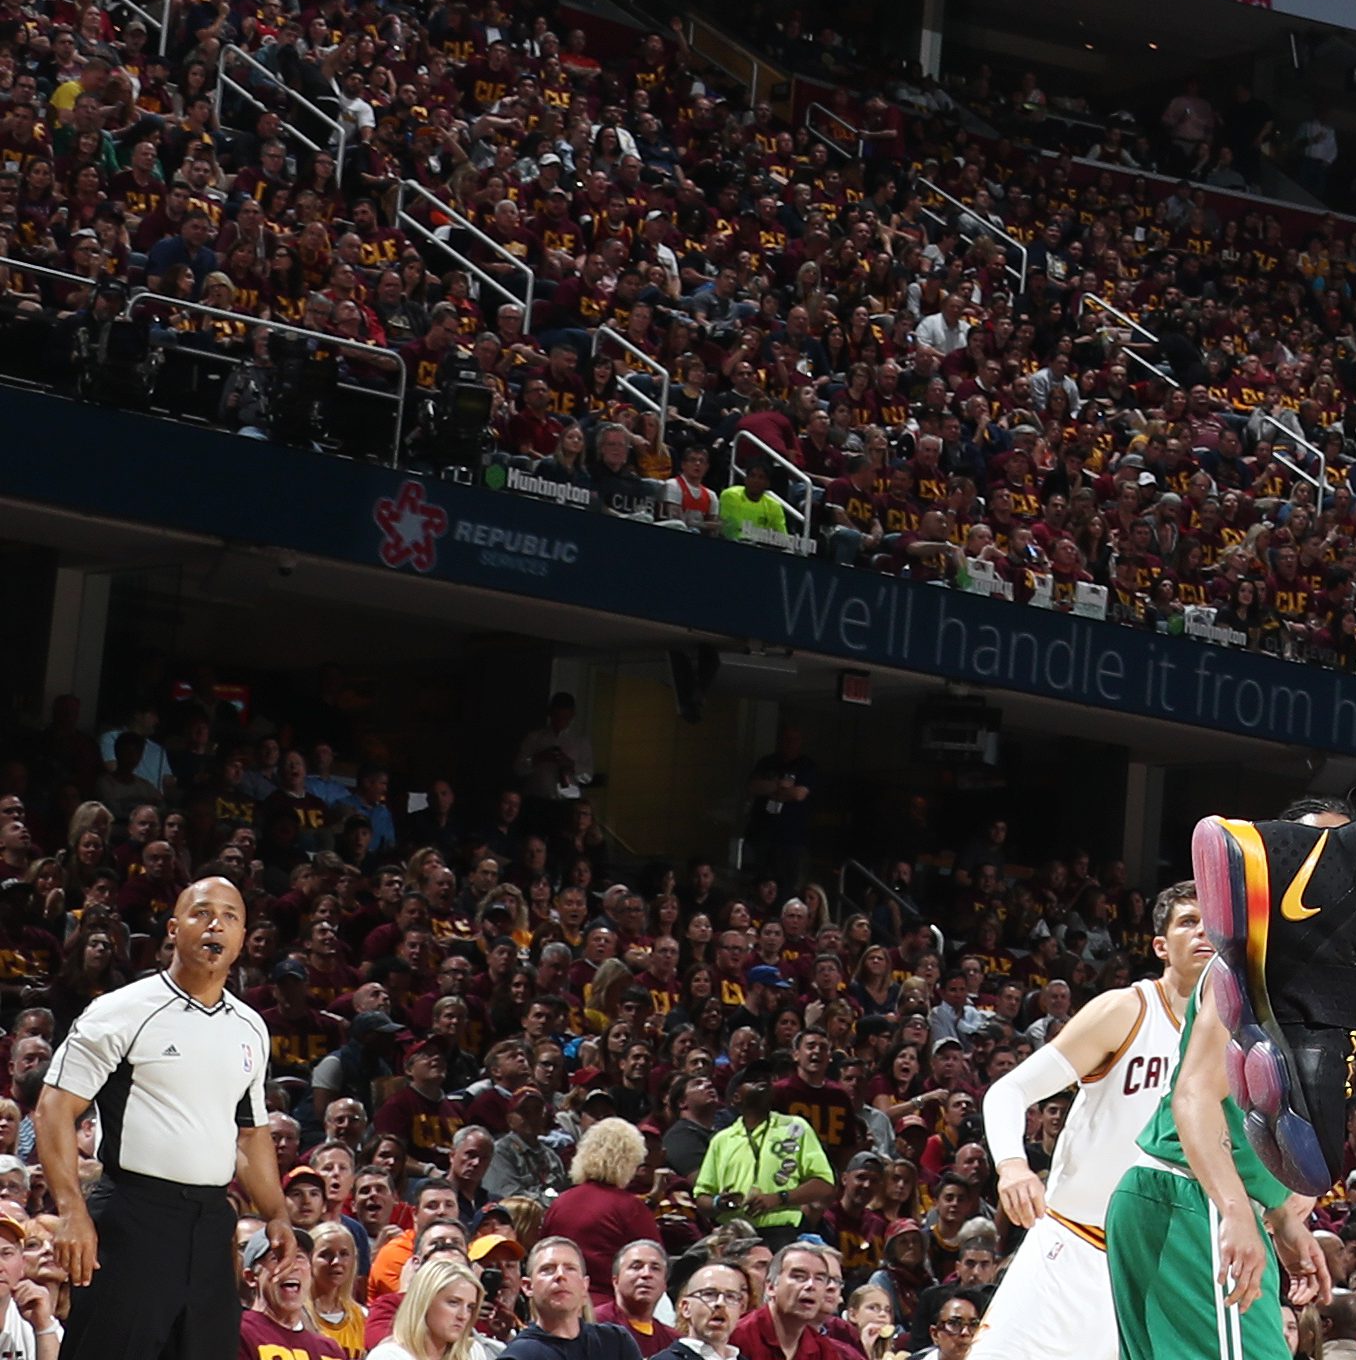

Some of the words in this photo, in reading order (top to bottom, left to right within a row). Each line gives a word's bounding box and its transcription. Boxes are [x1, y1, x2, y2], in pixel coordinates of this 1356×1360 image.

[507, 467, 592, 506] Huntington
[453, 520, 580, 564] REPUBLIC
[935, 594, 1125, 701] handle
[1145, 642, 1176, 712] it
[1194, 650, 1312, 739] from
